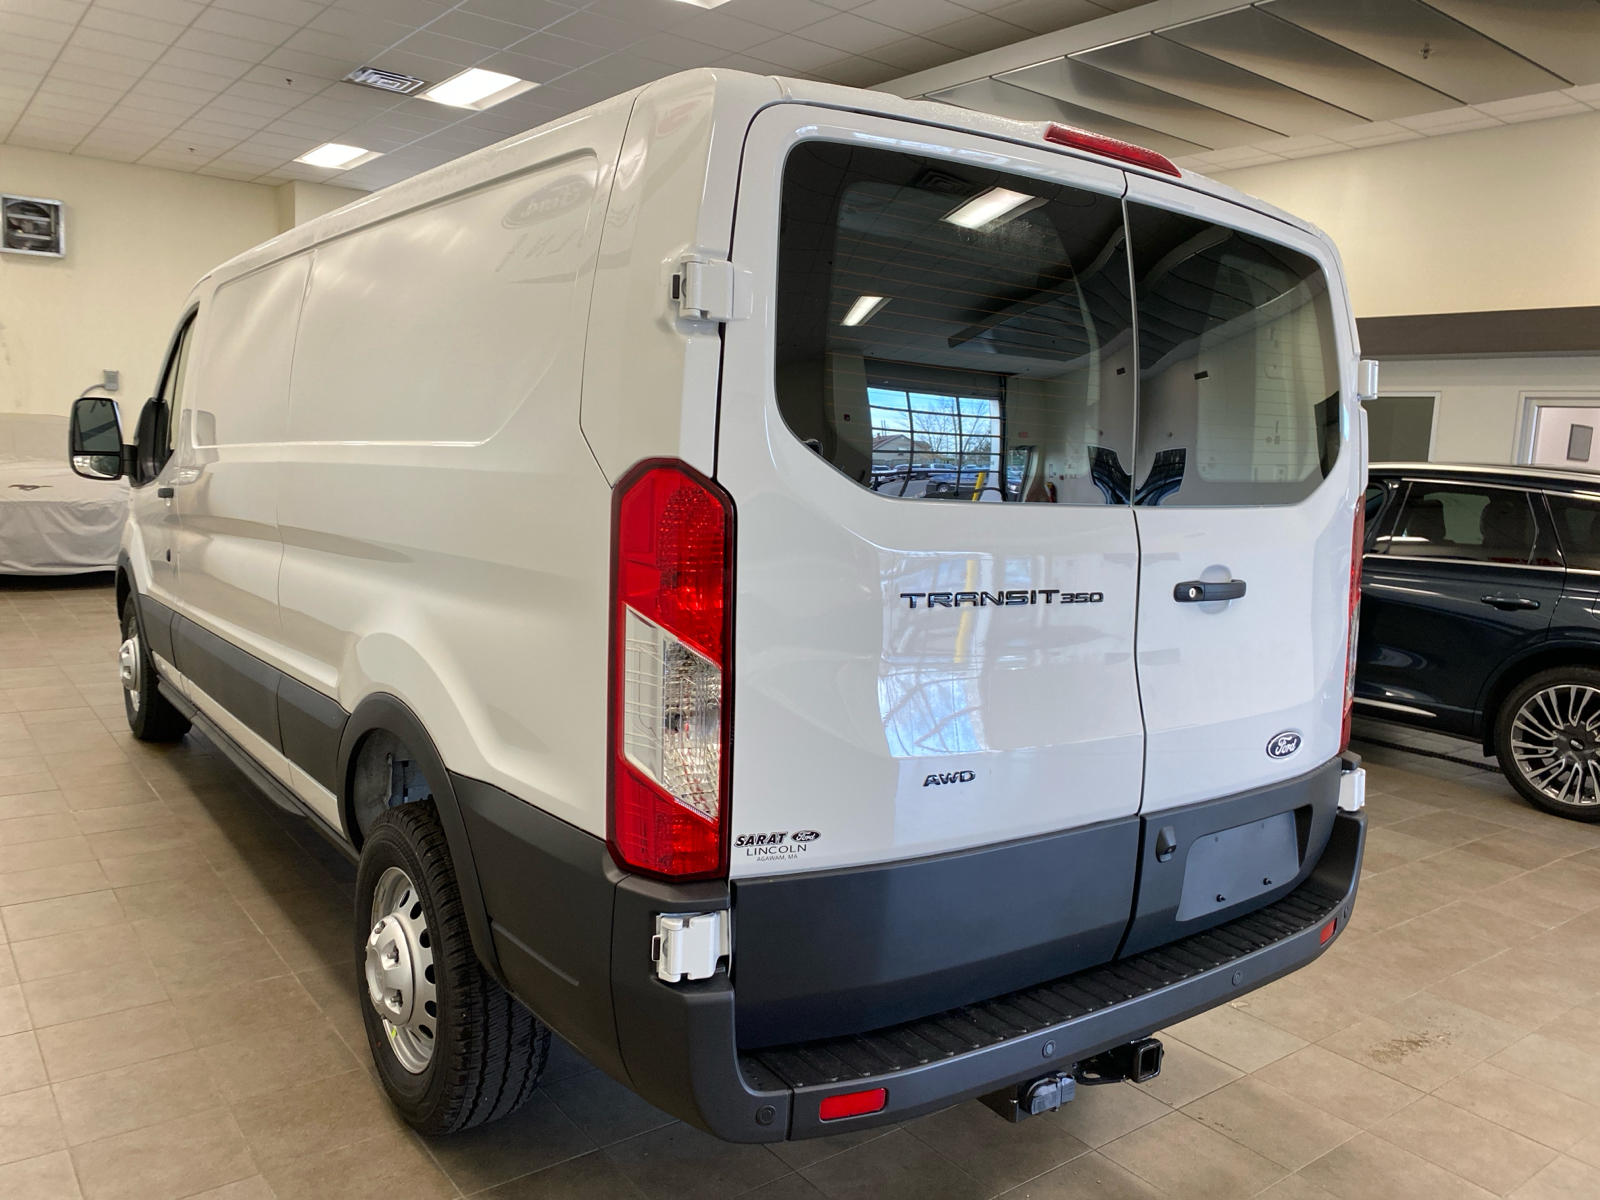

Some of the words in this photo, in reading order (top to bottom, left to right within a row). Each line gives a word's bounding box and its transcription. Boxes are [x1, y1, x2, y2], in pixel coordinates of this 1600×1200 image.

[923, 770, 976, 787] AWD
[735, 832, 788, 847] SARAT
[746, 844, 807, 856] LINCOLN
